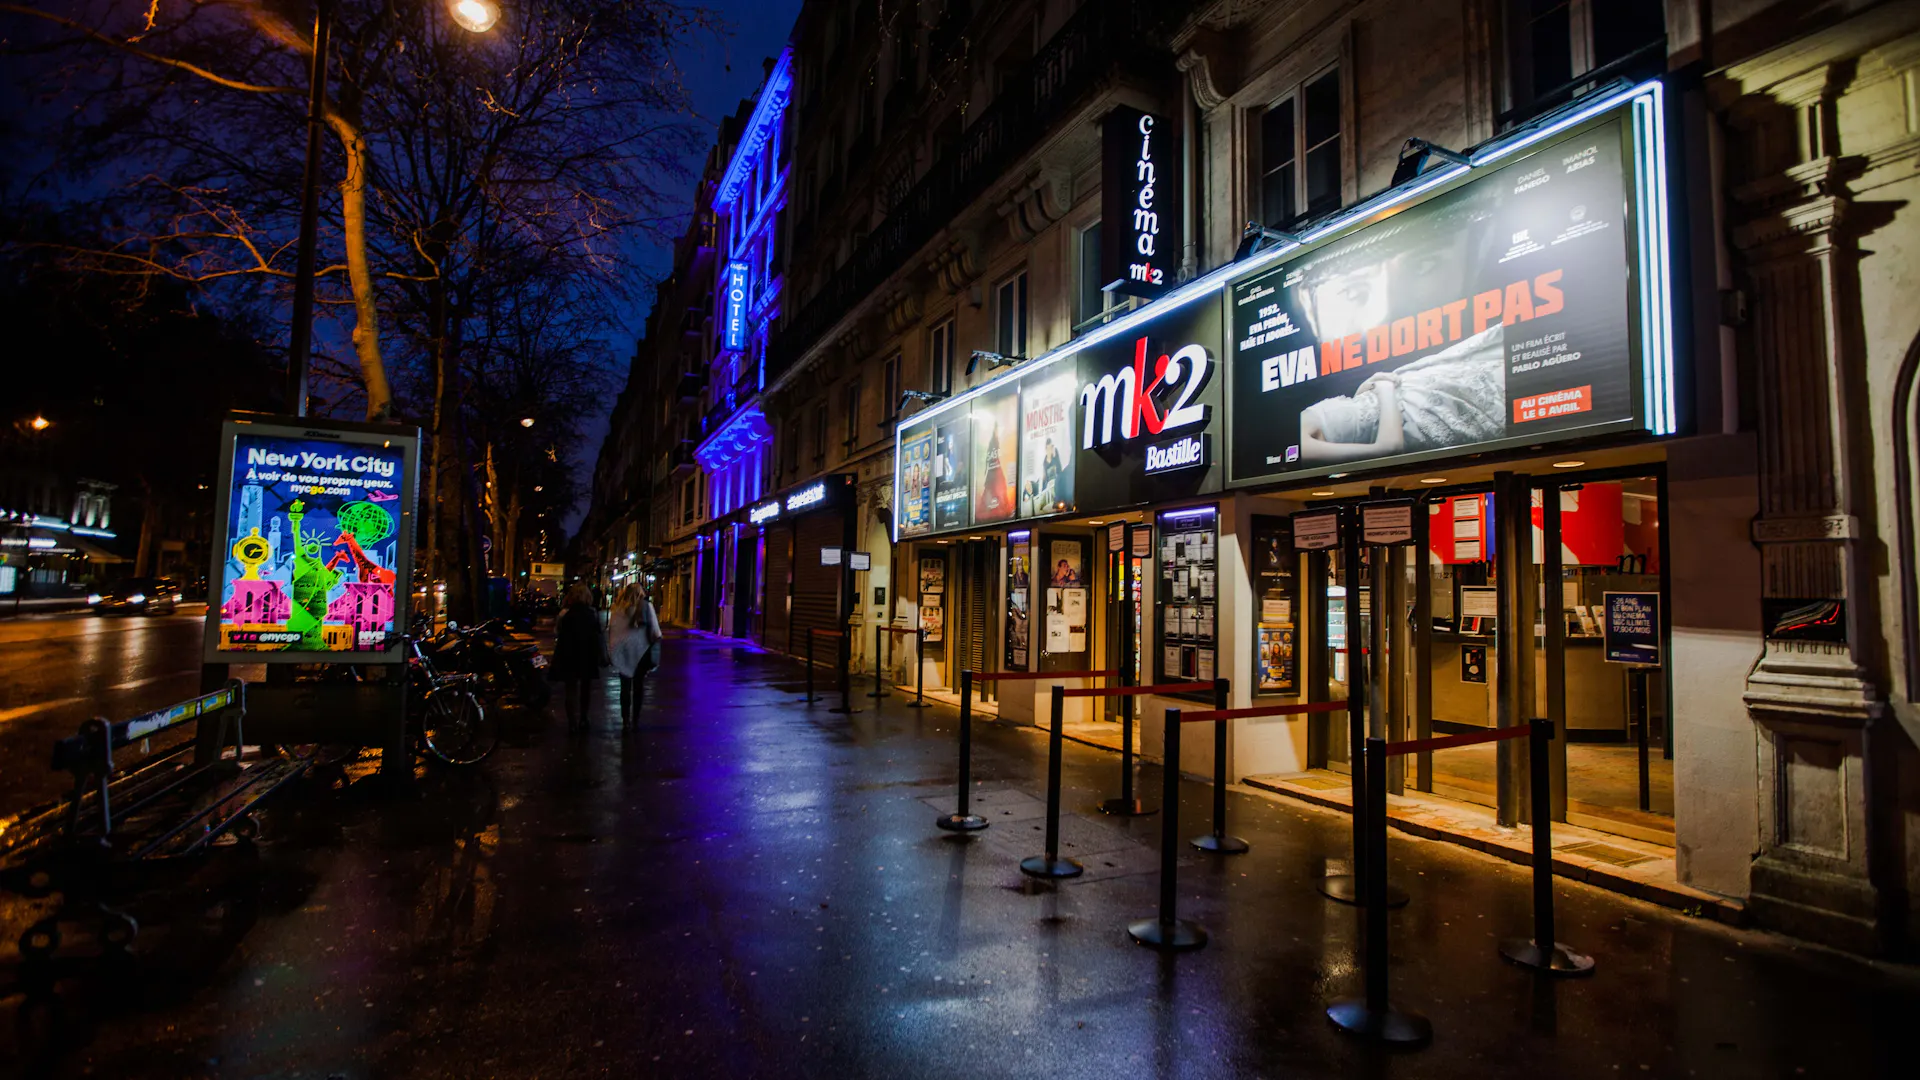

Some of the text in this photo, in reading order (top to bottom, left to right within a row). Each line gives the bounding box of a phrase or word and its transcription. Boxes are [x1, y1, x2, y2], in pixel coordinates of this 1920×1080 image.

[1562, 145, 1598, 166] IMANOL
[1565, 156, 1596, 174] ARIAS
[1133, 115, 1159, 257] cinéma
[1514, 174, 1550, 195] FANEGO
[1517, 167, 1546, 185] DANIEL
[1129, 262, 1163, 285] mk2
[731, 273, 744, 346] HOTEL
[1259, 303, 1280, 319] 1952.
[1249, 322, 1263, 336] EVA
[1262, 268, 1565, 393] EVA NE DORT PAS
[1257, 334, 1266, 346] ET
[1511, 331, 1566, 352] UN FILM ÉCRIT
[1512, 353, 1521, 363] ET
[1552, 343, 1567, 354] PAR
[1512, 351, 1581, 374] PABLO AGÜERO
[1080, 336, 1208, 450] mk2
[1521, 389, 1583, 409] AU CINÉMA
[1026, 402, 1065, 432] MONSTRE
[1523, 402, 1581, 419] LE 6 AVRIL
[247, 448, 395, 477] New York City
[1145, 437, 1201, 471] Bastille
[246, 467, 394, 489] À voir de vos propres yeux.
[290, 483, 351, 495] nycgo.com
[259, 633, 300, 643] @nycgo
[358, 631, 385, 641] NYC
